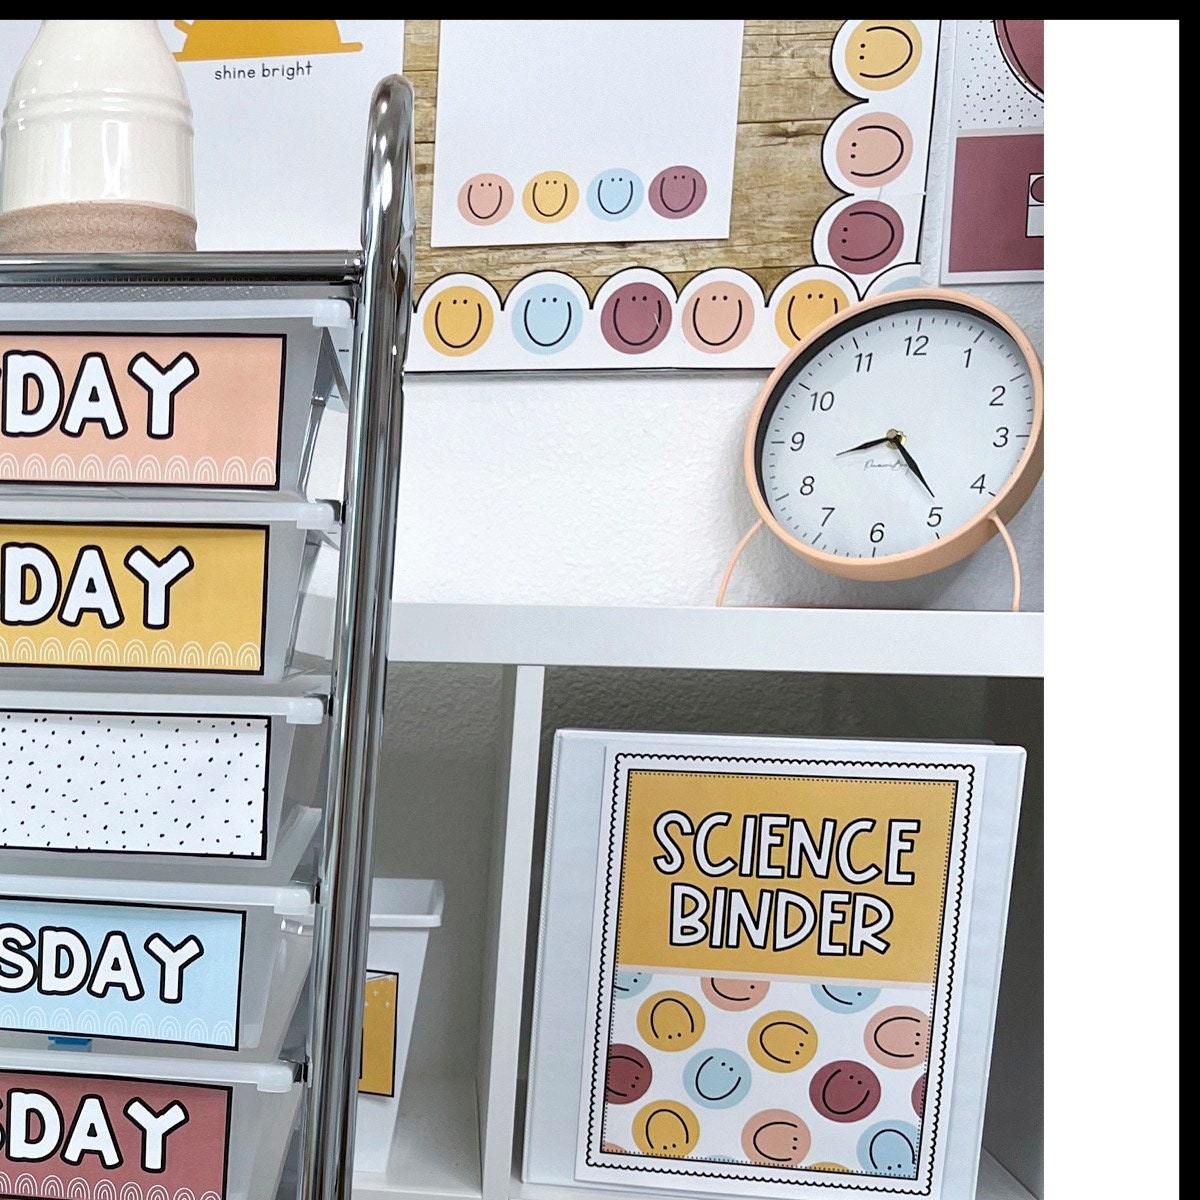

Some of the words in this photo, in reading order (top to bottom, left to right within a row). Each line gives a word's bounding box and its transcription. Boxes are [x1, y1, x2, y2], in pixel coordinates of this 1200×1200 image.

[214, 65, 256, 80] shine
[261, 60, 313, 80] bright
[904, 335, 930, 356] 12
[854, 352, 873, 373] 11
[963, 348, 972, 368] 1
[810, 391, 835, 412] 10
[989, 385, 1006, 407] 2
[790, 431, 805, 452] 9
[992, 426, 1009, 448] 3
[799, 475, 815, 496] 8
[970, 473, 986, 495] 4
[821, 507, 836, 527] 7
[926, 506, 944, 528] 5
[869, 522, 885, 544] 6
[652, 810, 920, 885] SCIENCE
[669, 882, 894, 956] BINDER
